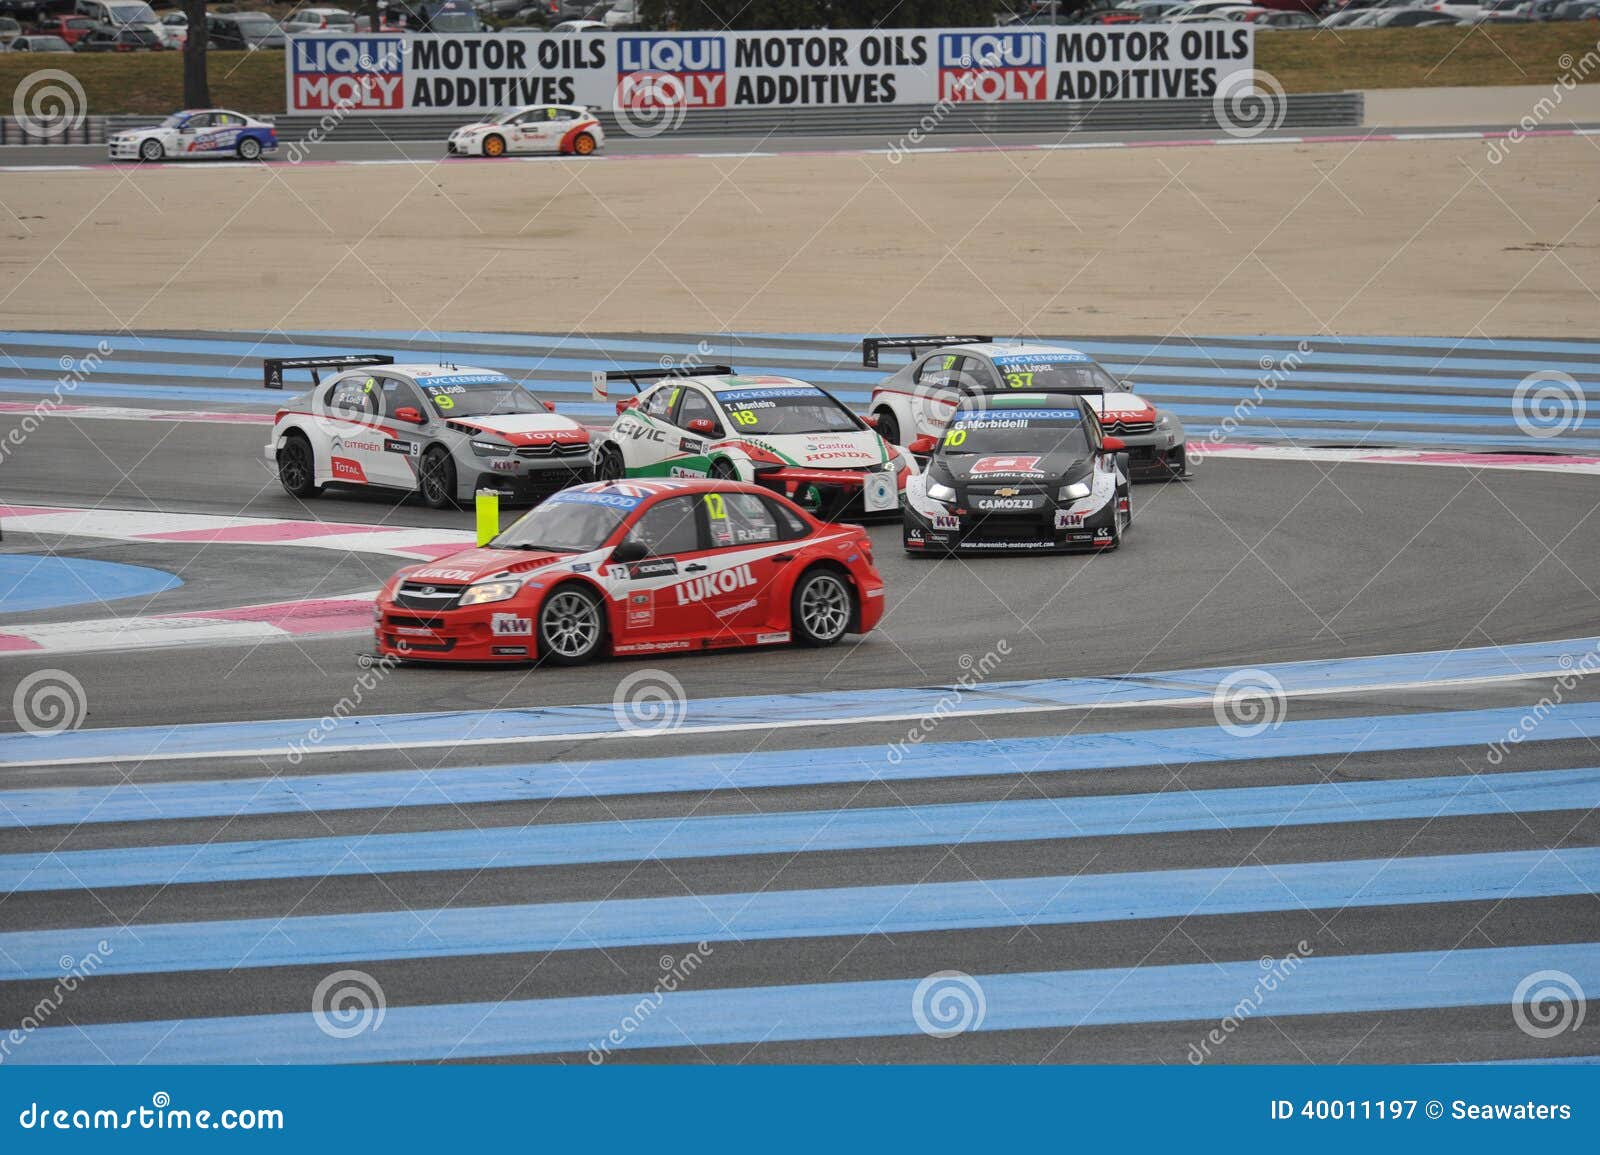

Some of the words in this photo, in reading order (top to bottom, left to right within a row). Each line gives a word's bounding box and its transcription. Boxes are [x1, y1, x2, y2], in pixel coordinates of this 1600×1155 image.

[411, 39, 527, 70] MOTOR
[537, 38, 606, 69] OILS
[621, 39, 721, 71] LIQUI
[734, 37, 849, 68] MOTOR
[859, 35, 928, 66] OILS
[943, 34, 1042, 67] LIQUI
[1055, 32, 1170, 63] MOTOR
[1180, 29, 1250, 60] OILS
[297, 40, 399, 74] LIQUI
[297, 75, 401, 107] MOLY
[411, 75, 576, 107] ADDITIVES
[622, 74, 724, 105] MOLY
[734, 72, 897, 105] ADDITIVES
[943, 70, 1045, 101] MOLY
[1055, 67, 1217, 100] ADDITIVES
[1007, 372, 1034, 389] 37
[434, 394, 455, 410] 9
[732, 410, 759, 426] 18
[1096, 411, 1143, 419] OTAL
[522, 431, 579, 440] TOTAL
[616, 422, 667, 442] CIVIC
[943, 429, 967, 447] 10
[412, 443, 419, 455] 9
[805, 451, 874, 462] HONDA
[334, 461, 360, 475] TOTAL
[703, 493, 727, 520] 12
[978, 499, 1034, 510] CAMOZZI
[936, 515, 958, 527] KW
[1059, 514, 1084, 526] KW
[410, 568, 477, 581] LUKOIL
[611, 566, 627, 580] 12
[675, 563, 758, 607] LUKOIL
[500, 619, 528, 633] KW
